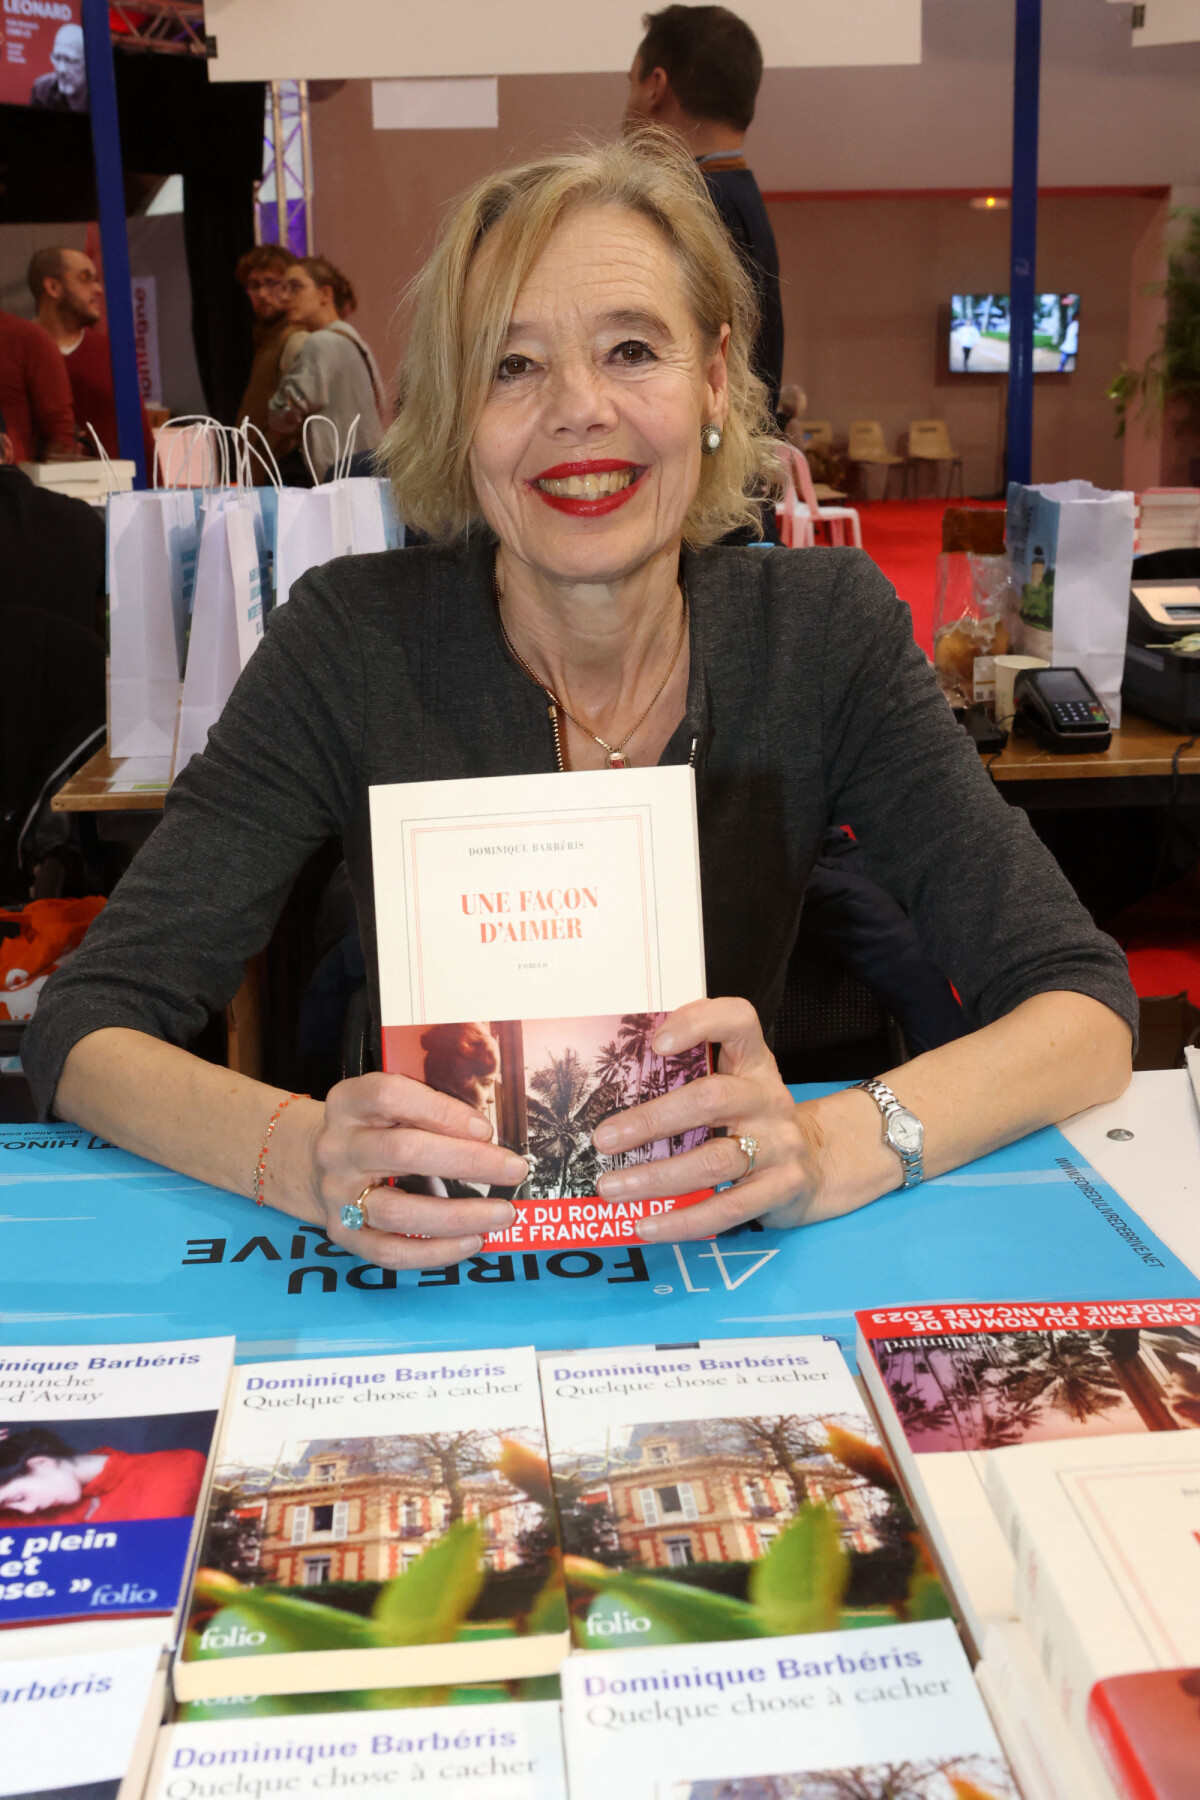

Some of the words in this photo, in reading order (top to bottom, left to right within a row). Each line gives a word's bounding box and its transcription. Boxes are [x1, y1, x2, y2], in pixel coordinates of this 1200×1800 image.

[469, 844, 529, 857] DOMINIQUE
[532, 840, 584, 853] BARBÉRIS
[461, 891, 511, 915] UNE
[519, 886, 598, 916] FAÇON
[480, 917, 583, 944] D'AIMER
[0, 1140, 79, 1150] HINO
[535, 1207, 562, 1223] DU
[569, 1202, 643, 1221] ROMAN
[1055, 1158, 1165, 1268] WWW.FOIREDULIVREDEBRIVE.NET
[529, 1219, 639, 1242] FRANÇAIS
[182, 1226, 354, 1265] RIVE
[288, 1264, 398, 1295] DU
[417, 1247, 649, 1288] FOIRE
[871, 1309, 938, 1323] 2023
[911, 1318, 943, 1332] DE
[940, 1304, 1076, 1320] FRANÇAISE
[949, 1315, 1038, 1331] ROMAN
[1042, 1314, 1077, 1328] DU
[1083, 1314, 1142, 1326] PRIX
[1146, 1311, 1200, 1324] AND
[884, 1332, 997, 1354] Gallimard
[0, 1358, 79, 1374] inique
[88, 1353, 201, 1369] Barbéris
[553, 1362, 692, 1382] Dominique
[699, 1353, 810, 1371] Barbéris
[0, 1374, 95, 1388] manche
[246, 1371, 386, 1391] Dominique
[395, 1363, 507, 1382] Barbéris
[556, 1380, 656, 1400] Quelque
[665, 1374, 728, 1389] chose
[736, 1372, 748, 1384] à
[757, 1369, 830, 1384] cacher
[0, 1390, 103, 1404] -d'Avray
[243, 1393, 345, 1410] Quelque
[353, 1389, 418, 1403] chose
[426, 1386, 438, 1398] à
[448, 1381, 523, 1397] cacher
[21, 1529, 118, 1559] plein
[90, 1583, 158, 1606] folio
[586, 1611, 652, 1637] folio
[200, 1626, 267, 1652] folio
[584, 1664, 767, 1698] Dominique
[777, 1647, 923, 1681] Barbéris
[0, 1674, 113, 1704] arbéris
[586, 1699, 719, 1731] Quelque
[731, 1691, 816, 1717] chose
[828, 1687, 844, 1707] à
[854, 1674, 953, 1704] cacher
[172, 1738, 359, 1770] Dominique
[371, 1727, 518, 1756] Barbéris
[166, 1766, 302, 1800] Quelque
[313, 1759, 400, 1790] chose
[411, 1758, 427, 1783] à
[439, 1752, 540, 1781] cacher
